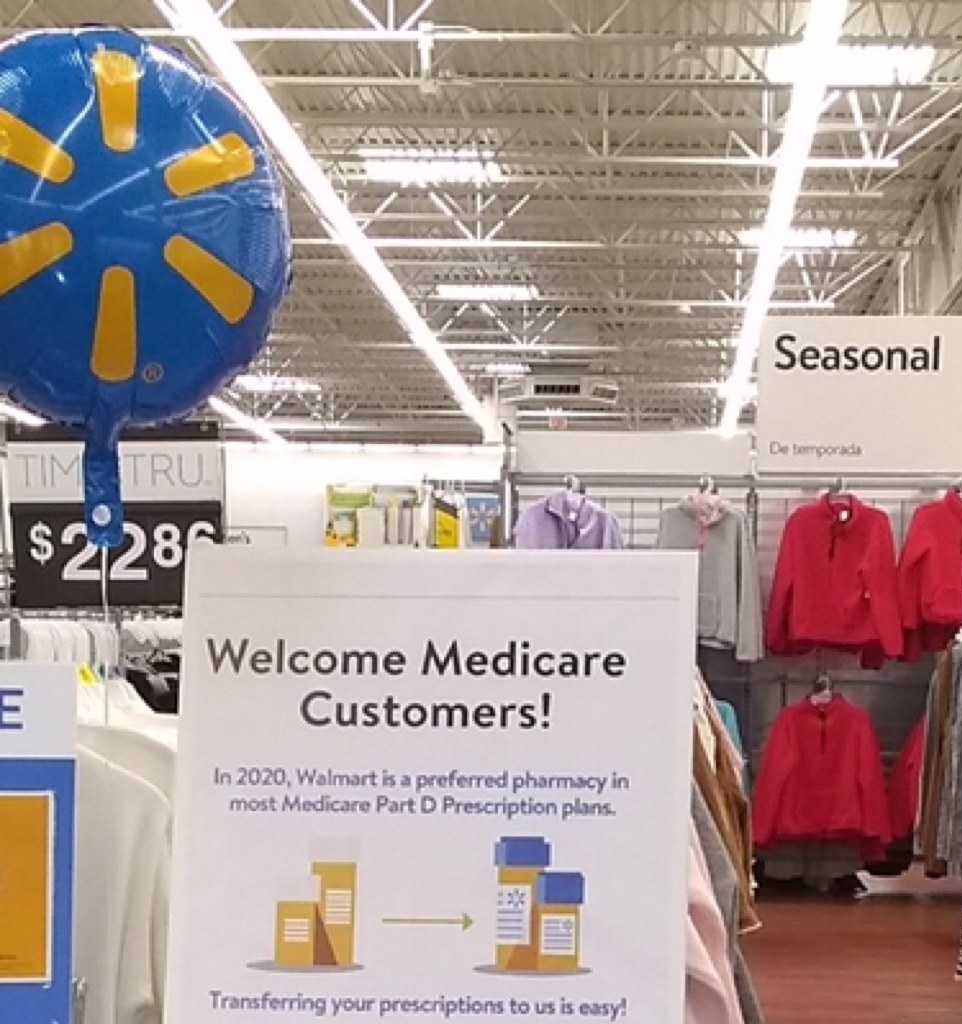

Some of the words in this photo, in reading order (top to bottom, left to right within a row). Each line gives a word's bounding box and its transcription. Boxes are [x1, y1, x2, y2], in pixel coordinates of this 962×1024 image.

[774, 333, 941, 372] Seasonal
[768, 440, 789, 456] De
[792, 441, 862, 458] temporada
[15, 453, 82, 488] TIM
[206, 637, 407, 676] Welcome
[421, 639, 627, 677] Medicare
[300, 691, 552, 730] Customers!
[213, 767, 232, 785] In
[236, 767, 291, 788] 2020,
[297, 768, 378, 787] Walmart
[382, 769, 397, 787] is
[400, 774, 412, 787] a
[415, 769, 509, 793] preferred
[512, 770, 608, 794] pharmacy
[611, 771, 630, 789] in
[229, 796, 277, 812] most
[282, 795, 371, 813] Medicare
[376, 795, 416, 814] Part
[420, 796, 437, 814] D
[442, 795, 558, 820] Prescription
[561, 798, 617, 820] plans.
[209, 990, 327, 1017] Transferring
[330, 997, 376, 1017] your
[379, 995, 504, 1019] prescriptions
[510, 997, 530, 1015] to
[535, 1000, 556, 1015] us
[560, 997, 575, 1015] is
[579, 997, 627, 1022] easy!
